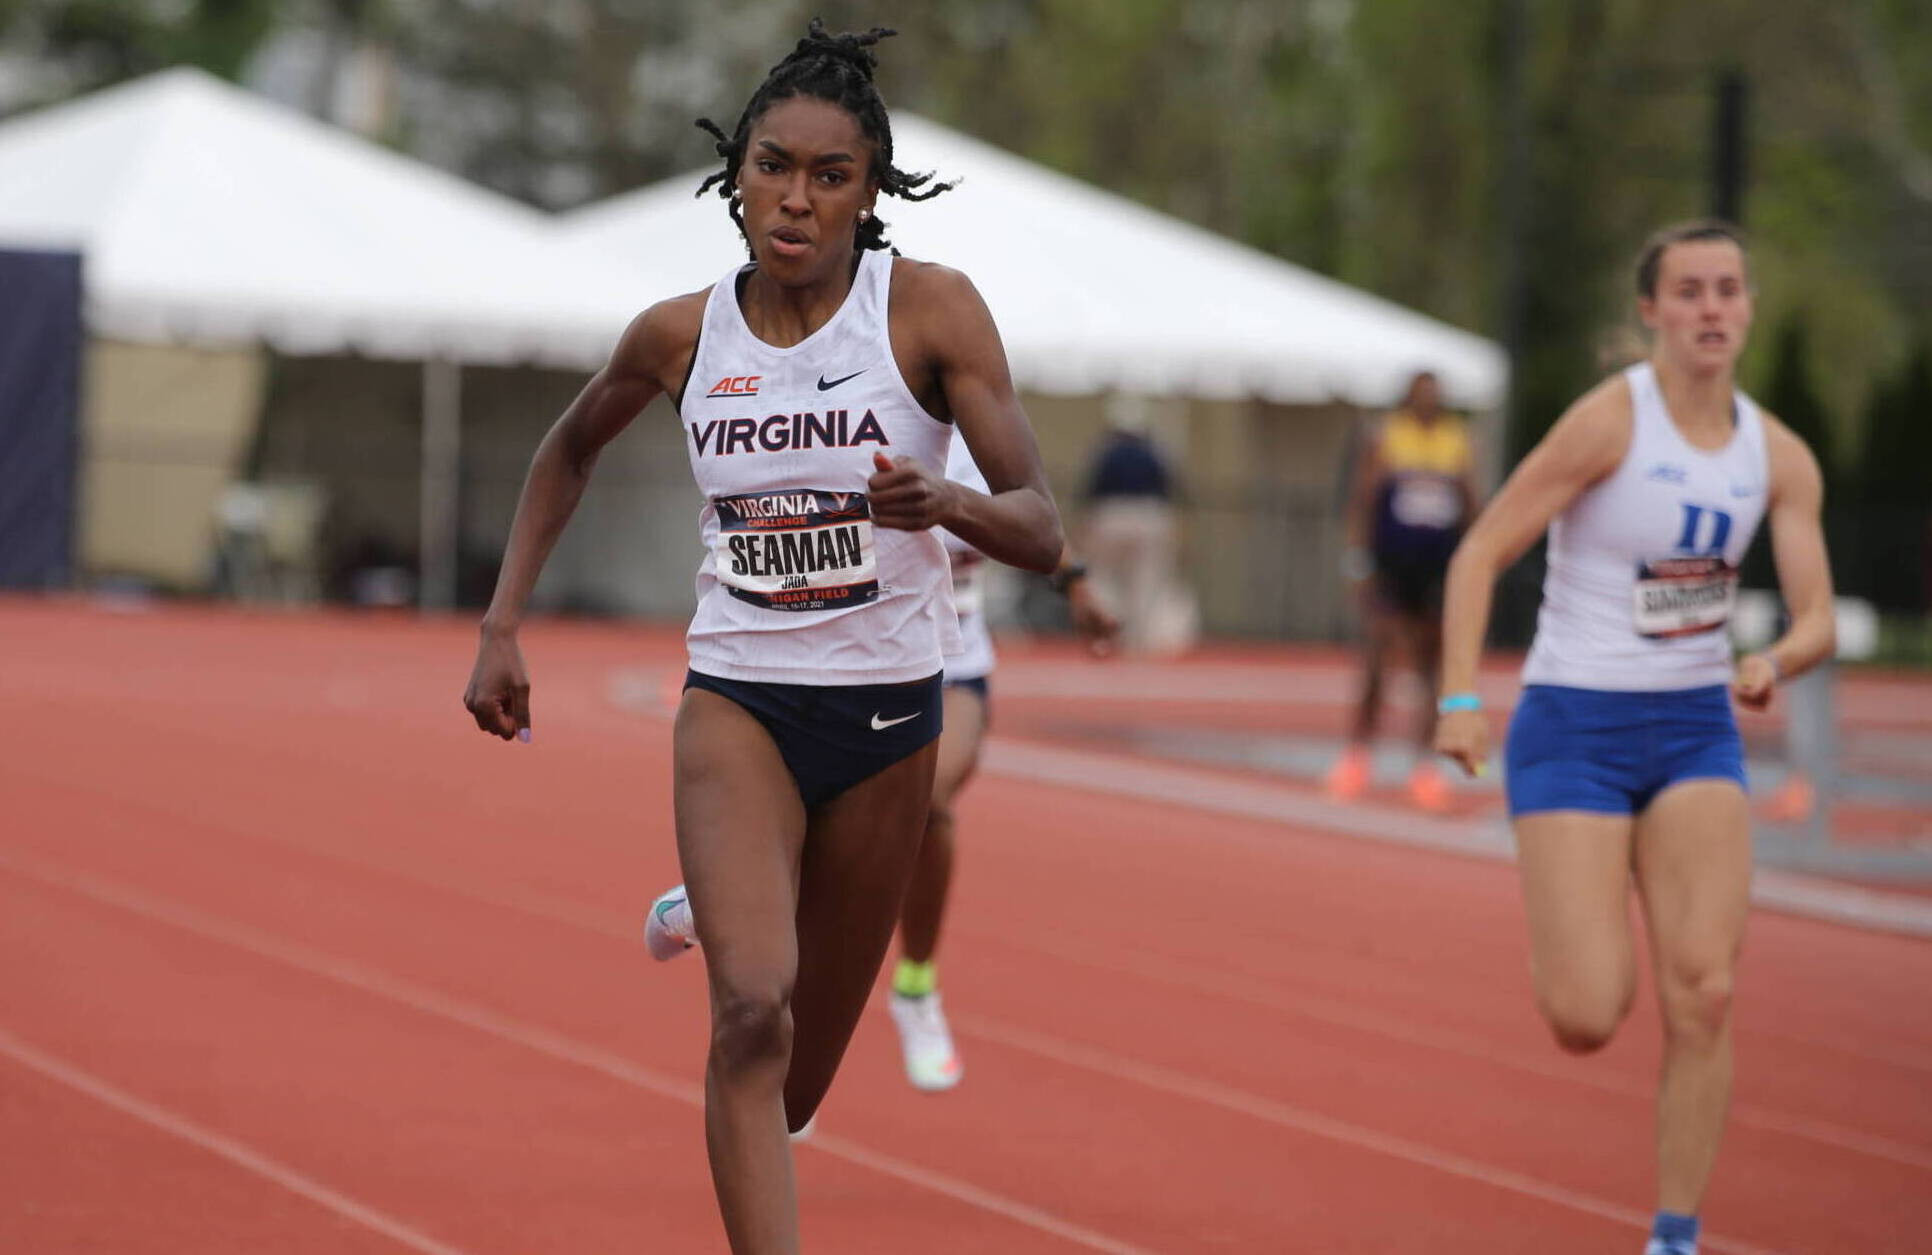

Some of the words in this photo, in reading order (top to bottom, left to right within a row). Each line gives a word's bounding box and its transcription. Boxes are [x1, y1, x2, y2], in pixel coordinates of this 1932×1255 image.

[709, 376, 763, 394] ACC
[691, 408, 889, 458] VIRGINIA
[728, 494, 820, 518] VIRGINIA
[746, 516, 808, 527] CHALLENGE
[1677, 503, 1731, 556] D
[728, 526, 862, 576] SEAMAN
[781, 575, 809, 590] JADA
[815, 588, 849, 600] FIELD
